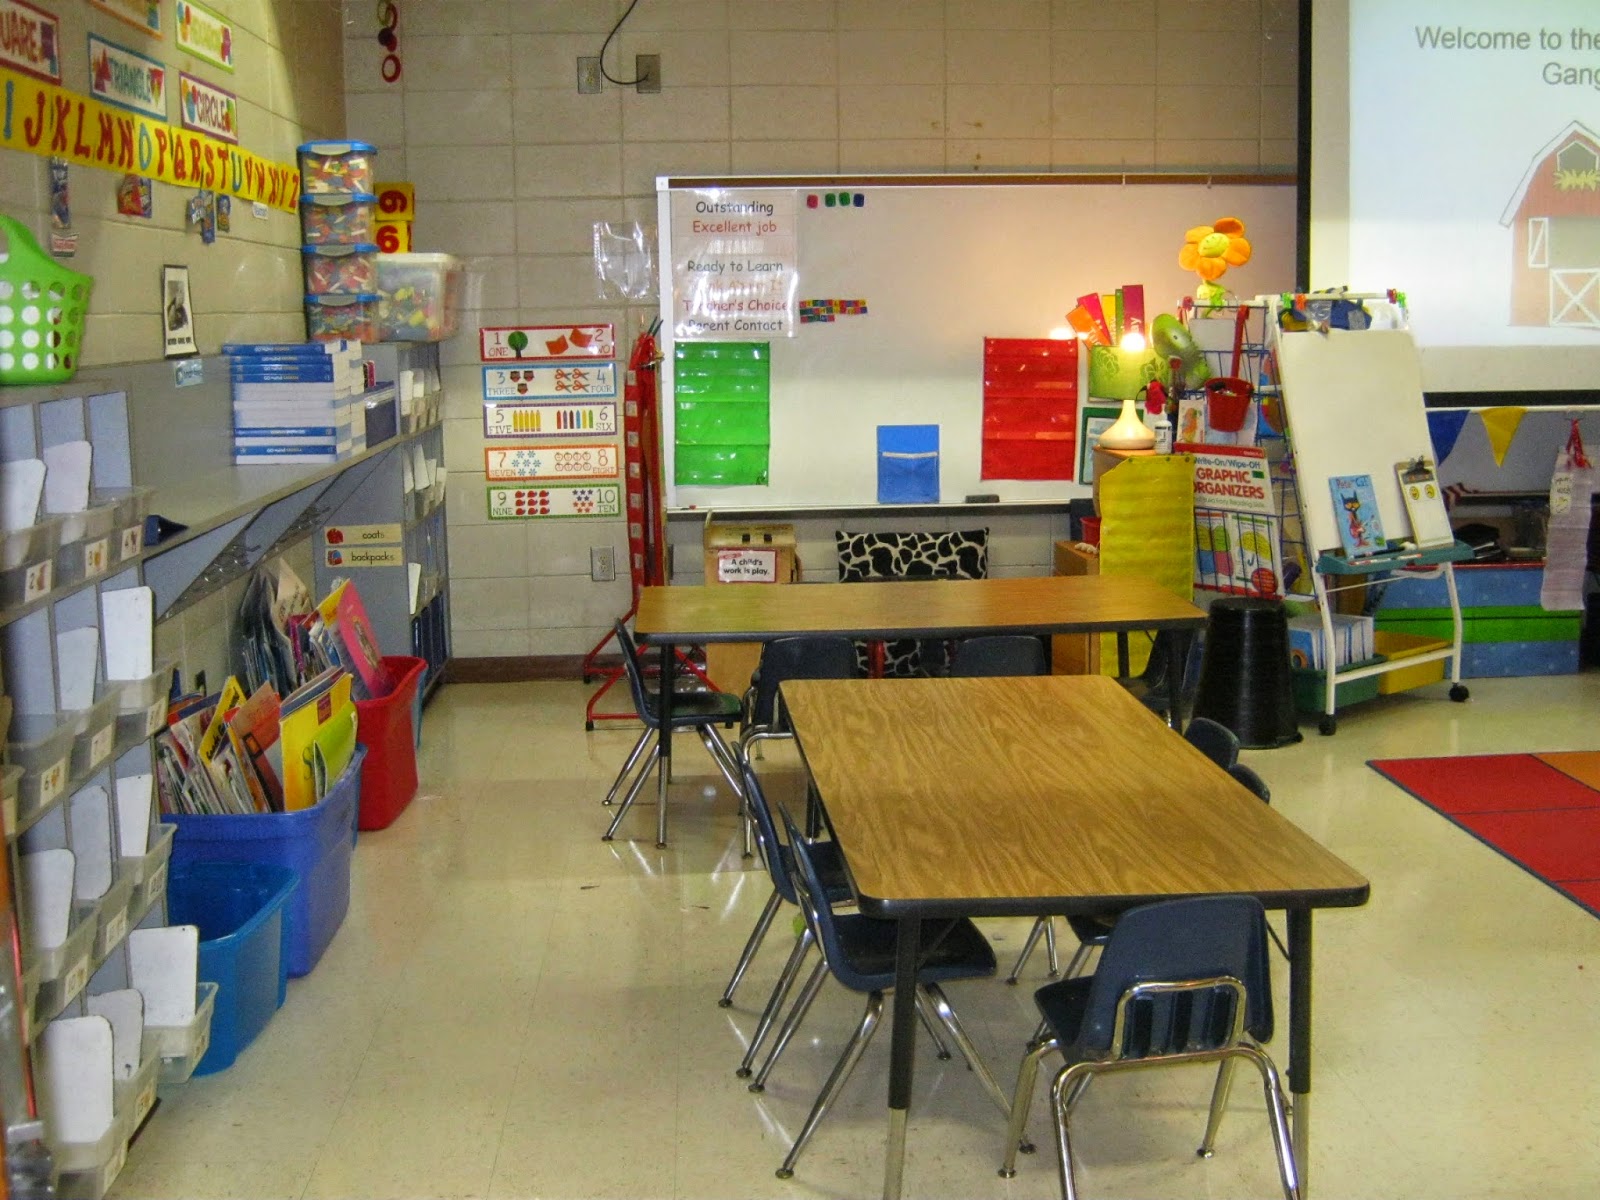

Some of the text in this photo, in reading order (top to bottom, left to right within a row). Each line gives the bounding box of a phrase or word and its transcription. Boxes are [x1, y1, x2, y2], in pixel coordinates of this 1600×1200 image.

[1414, 26, 1600, 51] Welcome to the
[696, 201, 774, 216] Outstanding
[692, 220, 777, 236] Excellent job
[376, 225, 400, 254] 6
[687, 260, 783, 275] Ready to Learn
[682, 299, 744, 312] Tcher's
[748, 299, 788, 312] Choice
[734, 320, 783, 331] Contact
[494, 332, 502, 345] 1
[594, 329, 604, 342] 2
[488, 347, 509, 357] ONE
[497, 371, 506, 385] 3
[597, 371, 606, 383] 4
[488, 387, 517, 396] THREE
[591, 385, 613, 393] FOUR
[495, 409, 505, 423] 5
[599, 406, 609, 421] 6
[488, 425, 512, 435] FIVE
[595, 422, 613, 431] SIX
[497, 452, 507, 468] 7
[598, 449, 609, 467] 8
[1194, 457, 1261, 470] Write-On/Wipe-Off
[490, 469, 517, 477] SEVEN
[592, 466, 615, 475] EIGHT
[1196, 468, 1251, 485] GRAPHIC
[497, 491, 507, 506] 9
[597, 488, 616, 504] 10
[492, 507, 513, 516] NINE
[598, 504, 616, 513] TEN
[362, 530, 385, 539] coats
[351, 551, 394, 565] backpacks
